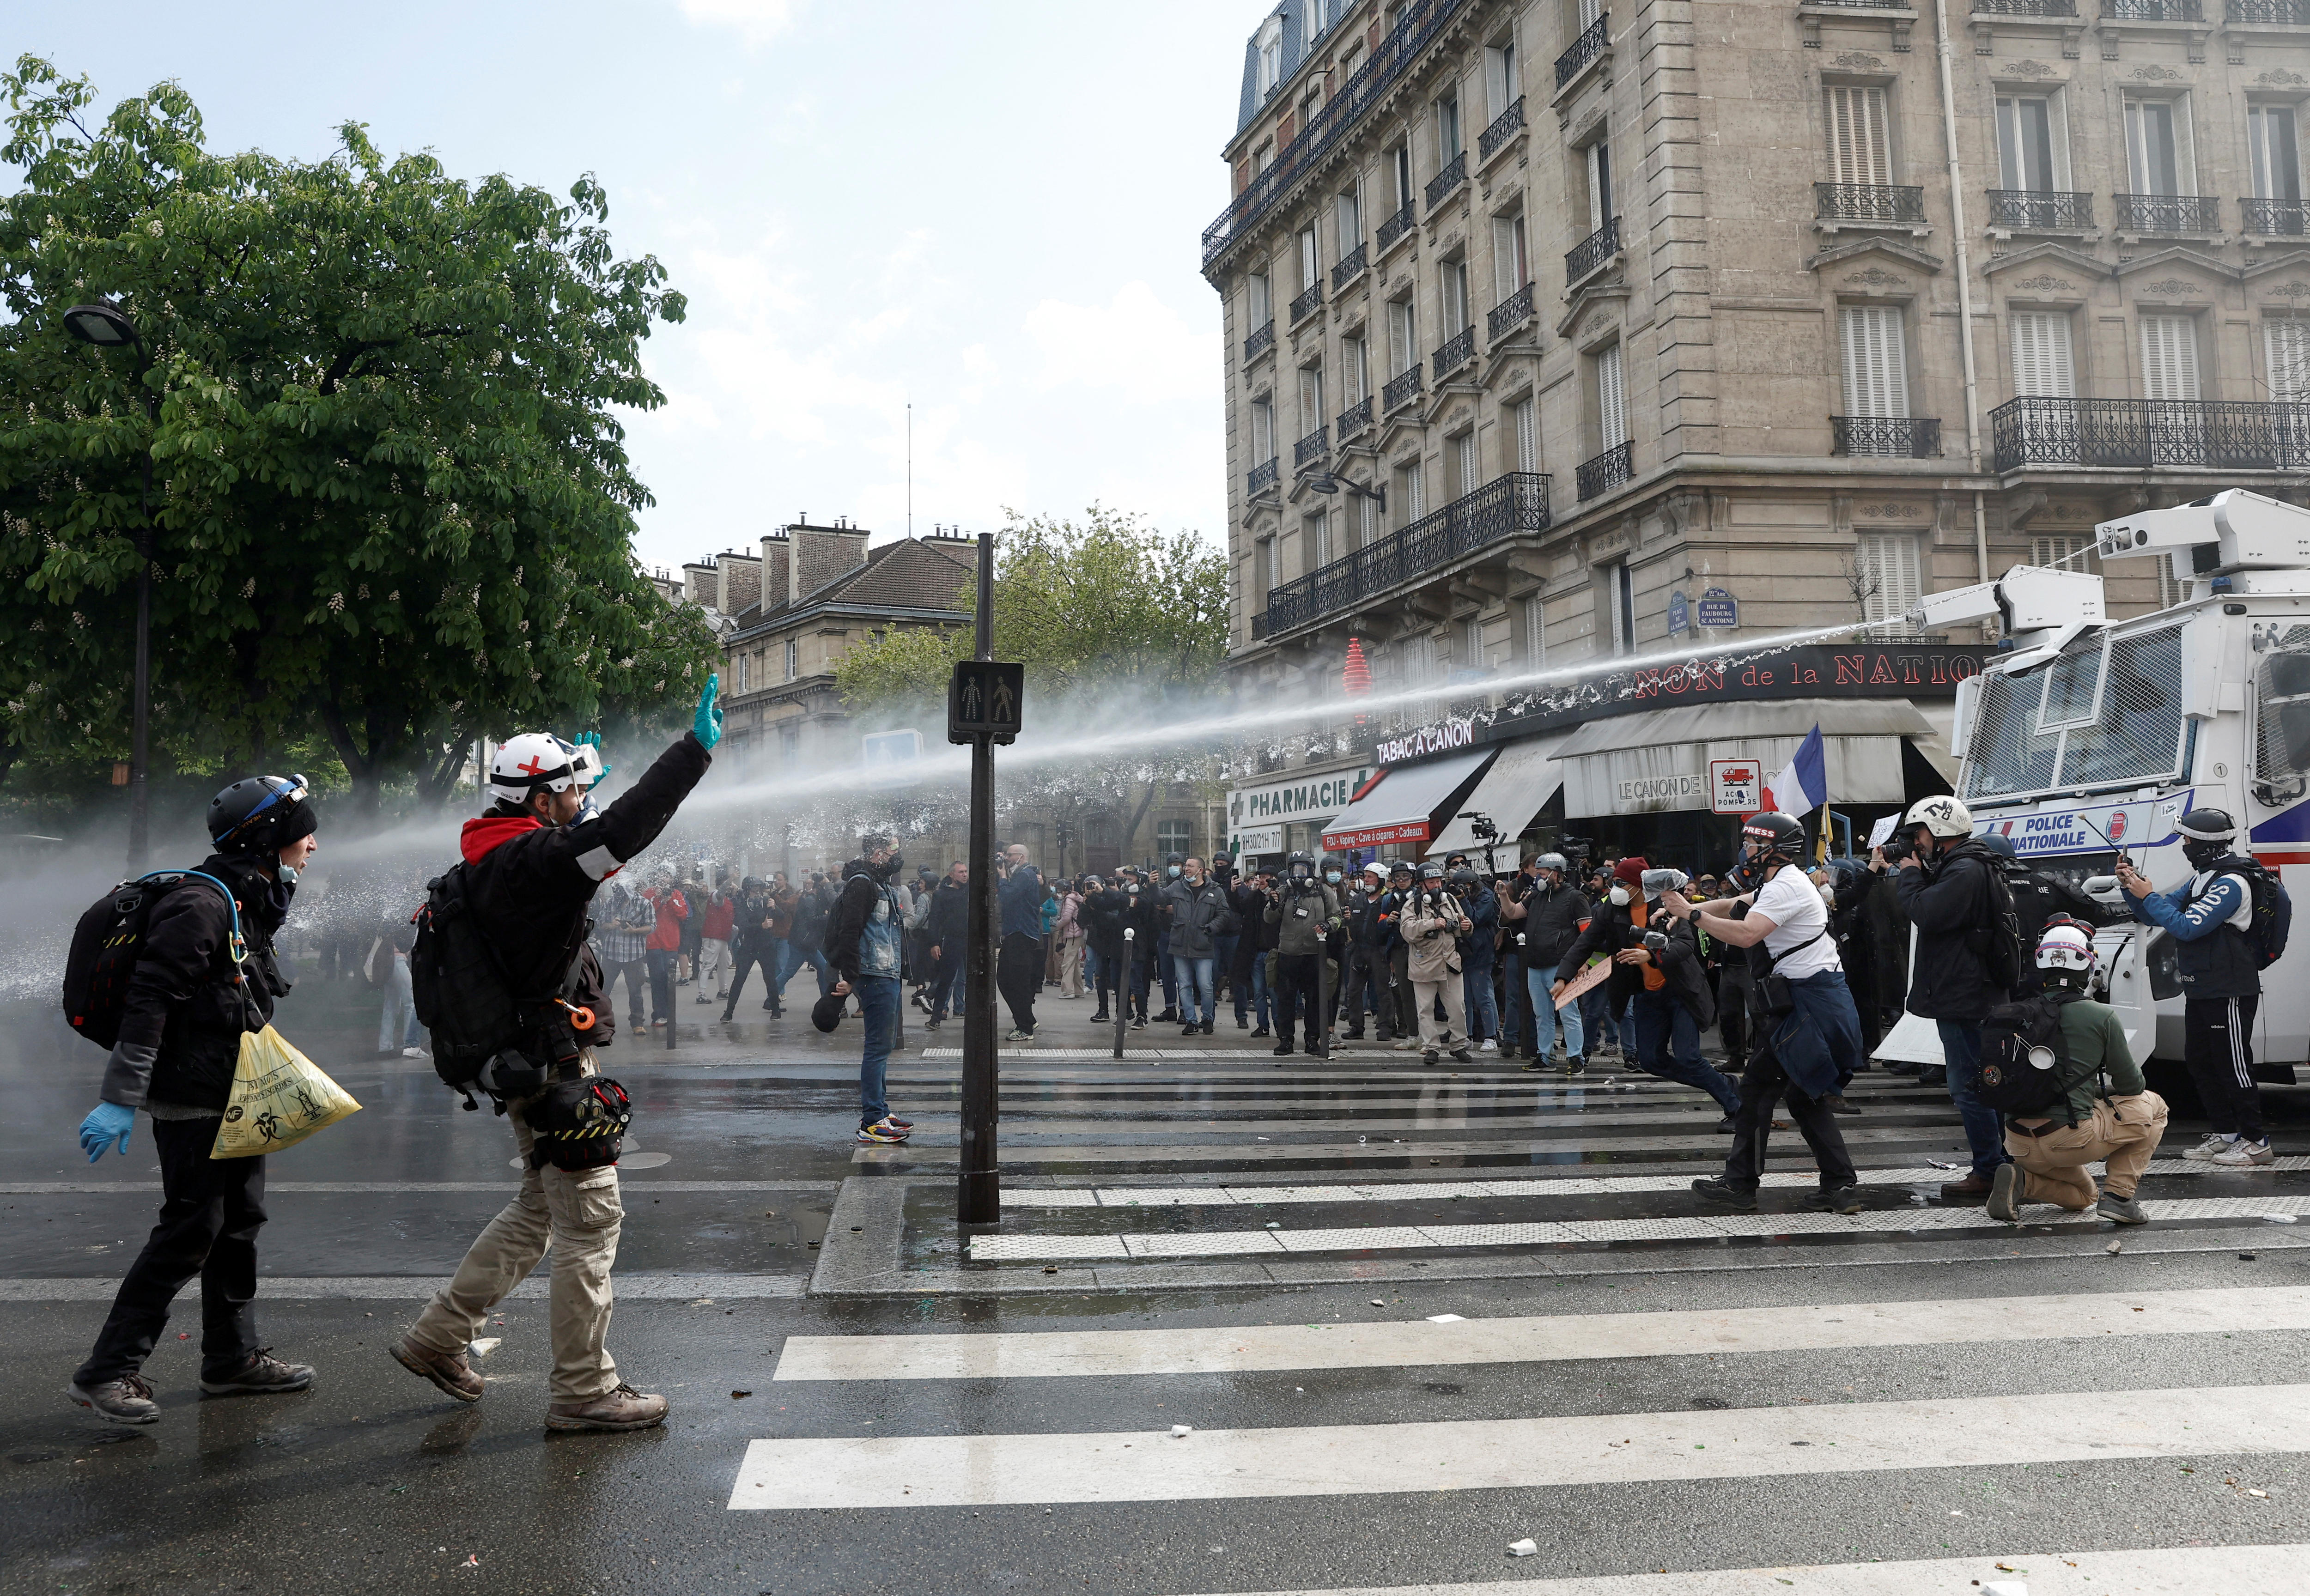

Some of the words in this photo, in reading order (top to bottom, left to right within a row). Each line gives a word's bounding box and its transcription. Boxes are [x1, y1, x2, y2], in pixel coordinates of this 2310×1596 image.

[1672, 608, 1683, 616] PLACE
[1675, 620, 1687, 630] NATION
[1741, 665, 1775, 686] de
[1790, 662, 1820, 685] la
[1834, 654, 1990, 685] NATIO
[1377, 739, 1412, 764] TABAC
[1427, 723, 1472, 752] CANON
[1619, 782, 1632, 800] LE
[1634, 778, 1679, 799] CANON
[1681, 777, 1701, 795] DE
[1250, 779, 1346, 818] PHARMACIE
[1924, 801, 1948, 817] TV
[1743, 826, 1775, 838] PRESS
[2025, 814, 2073, 832] POLICE
[1242, 832, 1269, 850] 8H30/21H
[1271, 831, 1280, 848] 7/7
[1326, 837, 1336, 846] FDJ
[1339, 835, 1355, 846] Vaping
[1359, 832, 1371, 843] Cave
[1376, 830, 1394, 843] cigares
[1399, 826, 1422, 837] Cadeaux
[2010, 831, 2086, 850] NATIONALE
[1424, 868, 1443, 877] PRESS
[226, 1109, 242, 1120] NF
